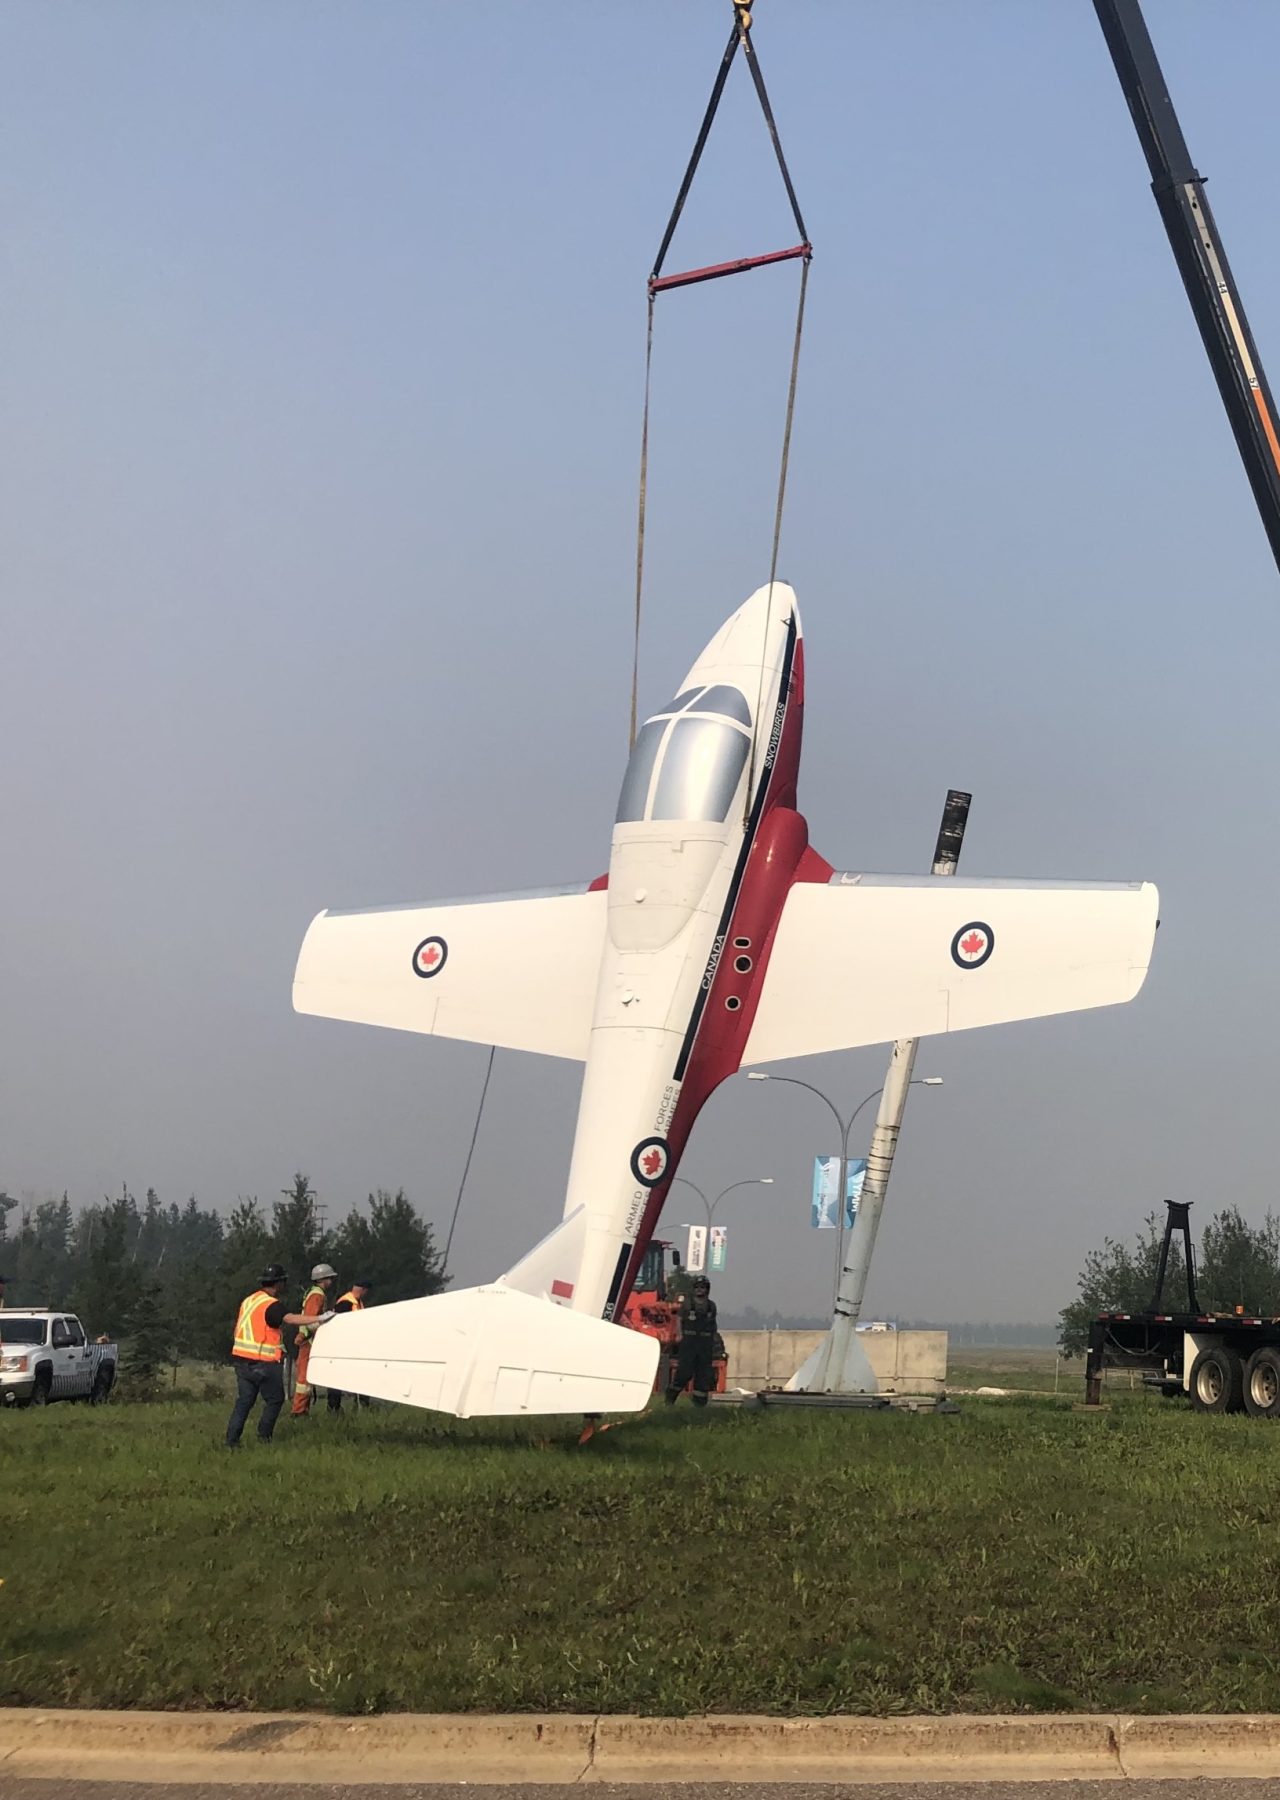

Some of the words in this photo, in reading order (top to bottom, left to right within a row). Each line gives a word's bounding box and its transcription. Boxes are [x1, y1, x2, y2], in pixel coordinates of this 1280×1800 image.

[764, 702, 785, 770] SNOWBIRDS
[702, 935, 725, 989] CANADA
[654, 1085, 674, 1133] FORCES
[624, 1190, 643, 1234] ARMED
